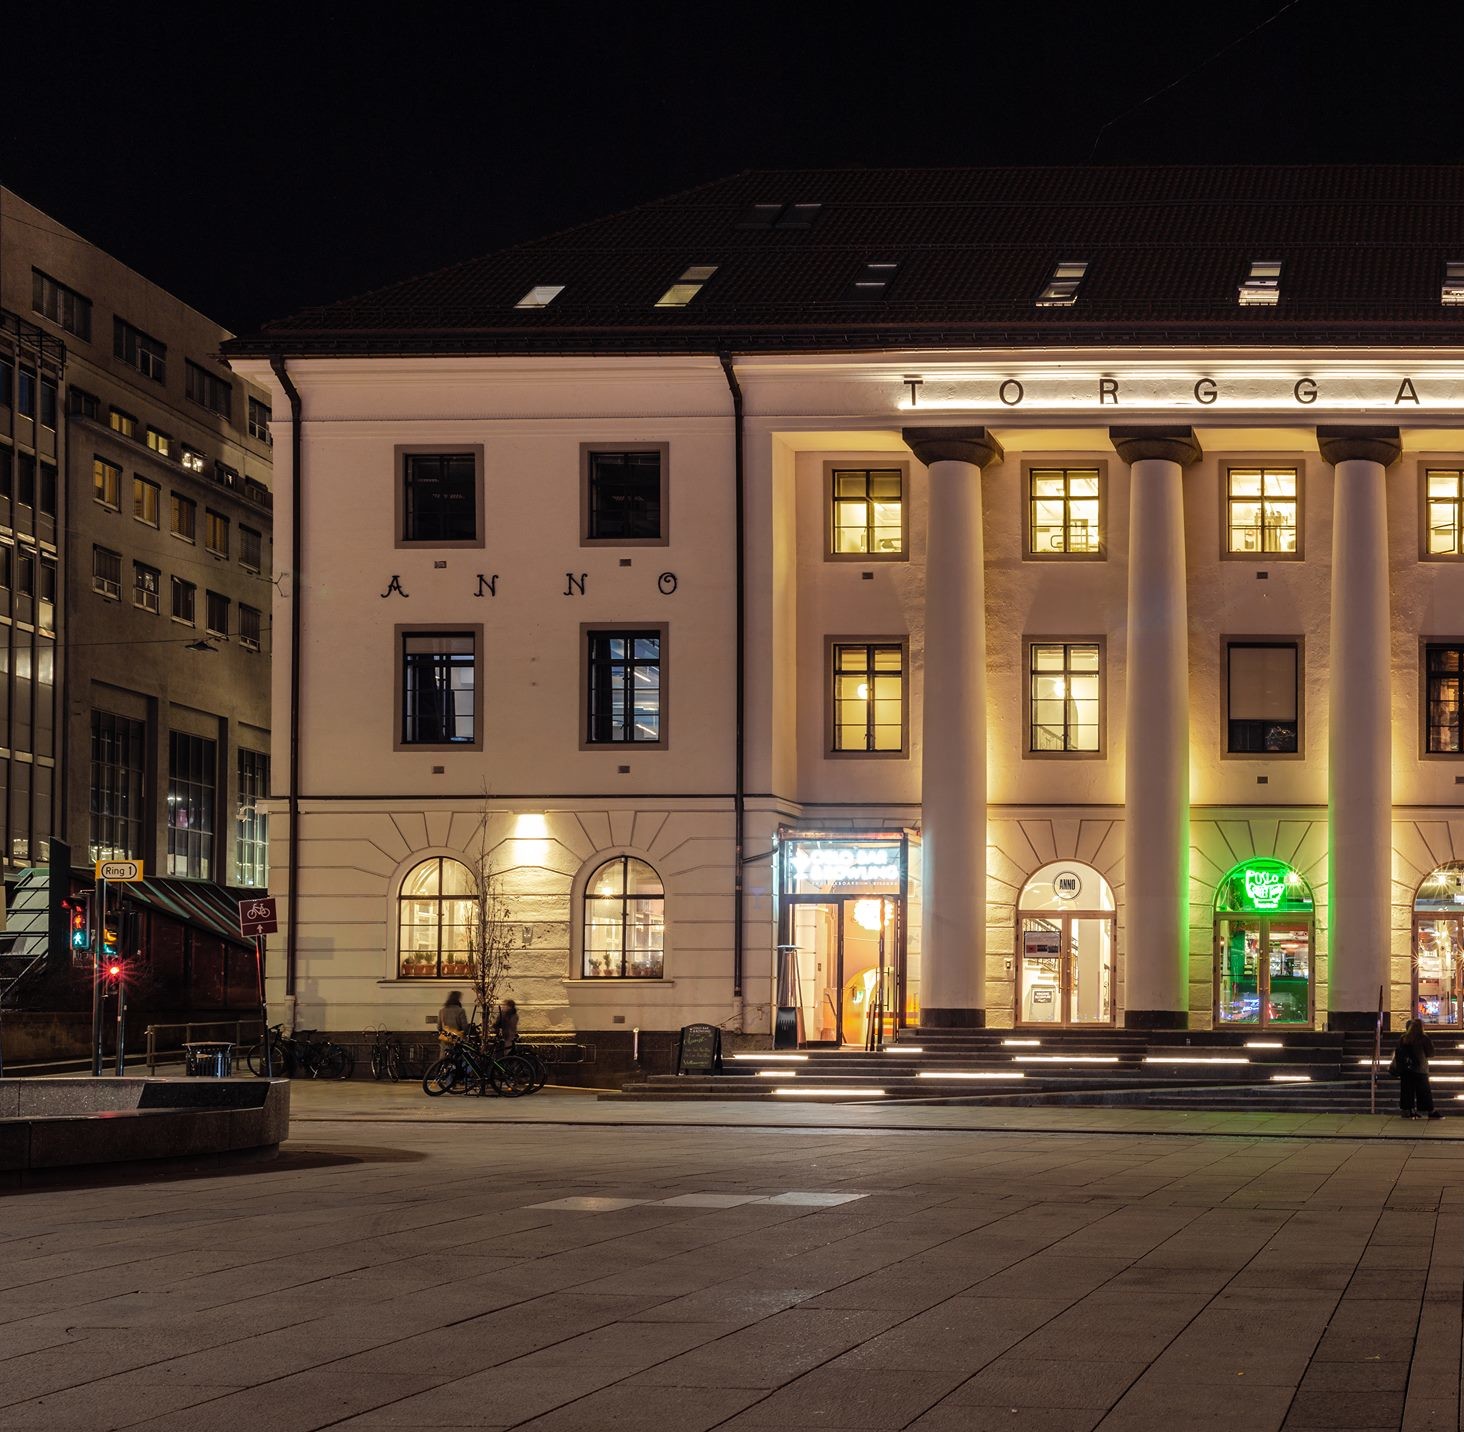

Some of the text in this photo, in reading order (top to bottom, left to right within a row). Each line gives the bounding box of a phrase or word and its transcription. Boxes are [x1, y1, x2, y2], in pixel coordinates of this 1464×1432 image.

[381, 572, 678, 598] ANNO
[106, 866, 125, 876] Ring
[1059, 879, 1076, 890] ANNO
